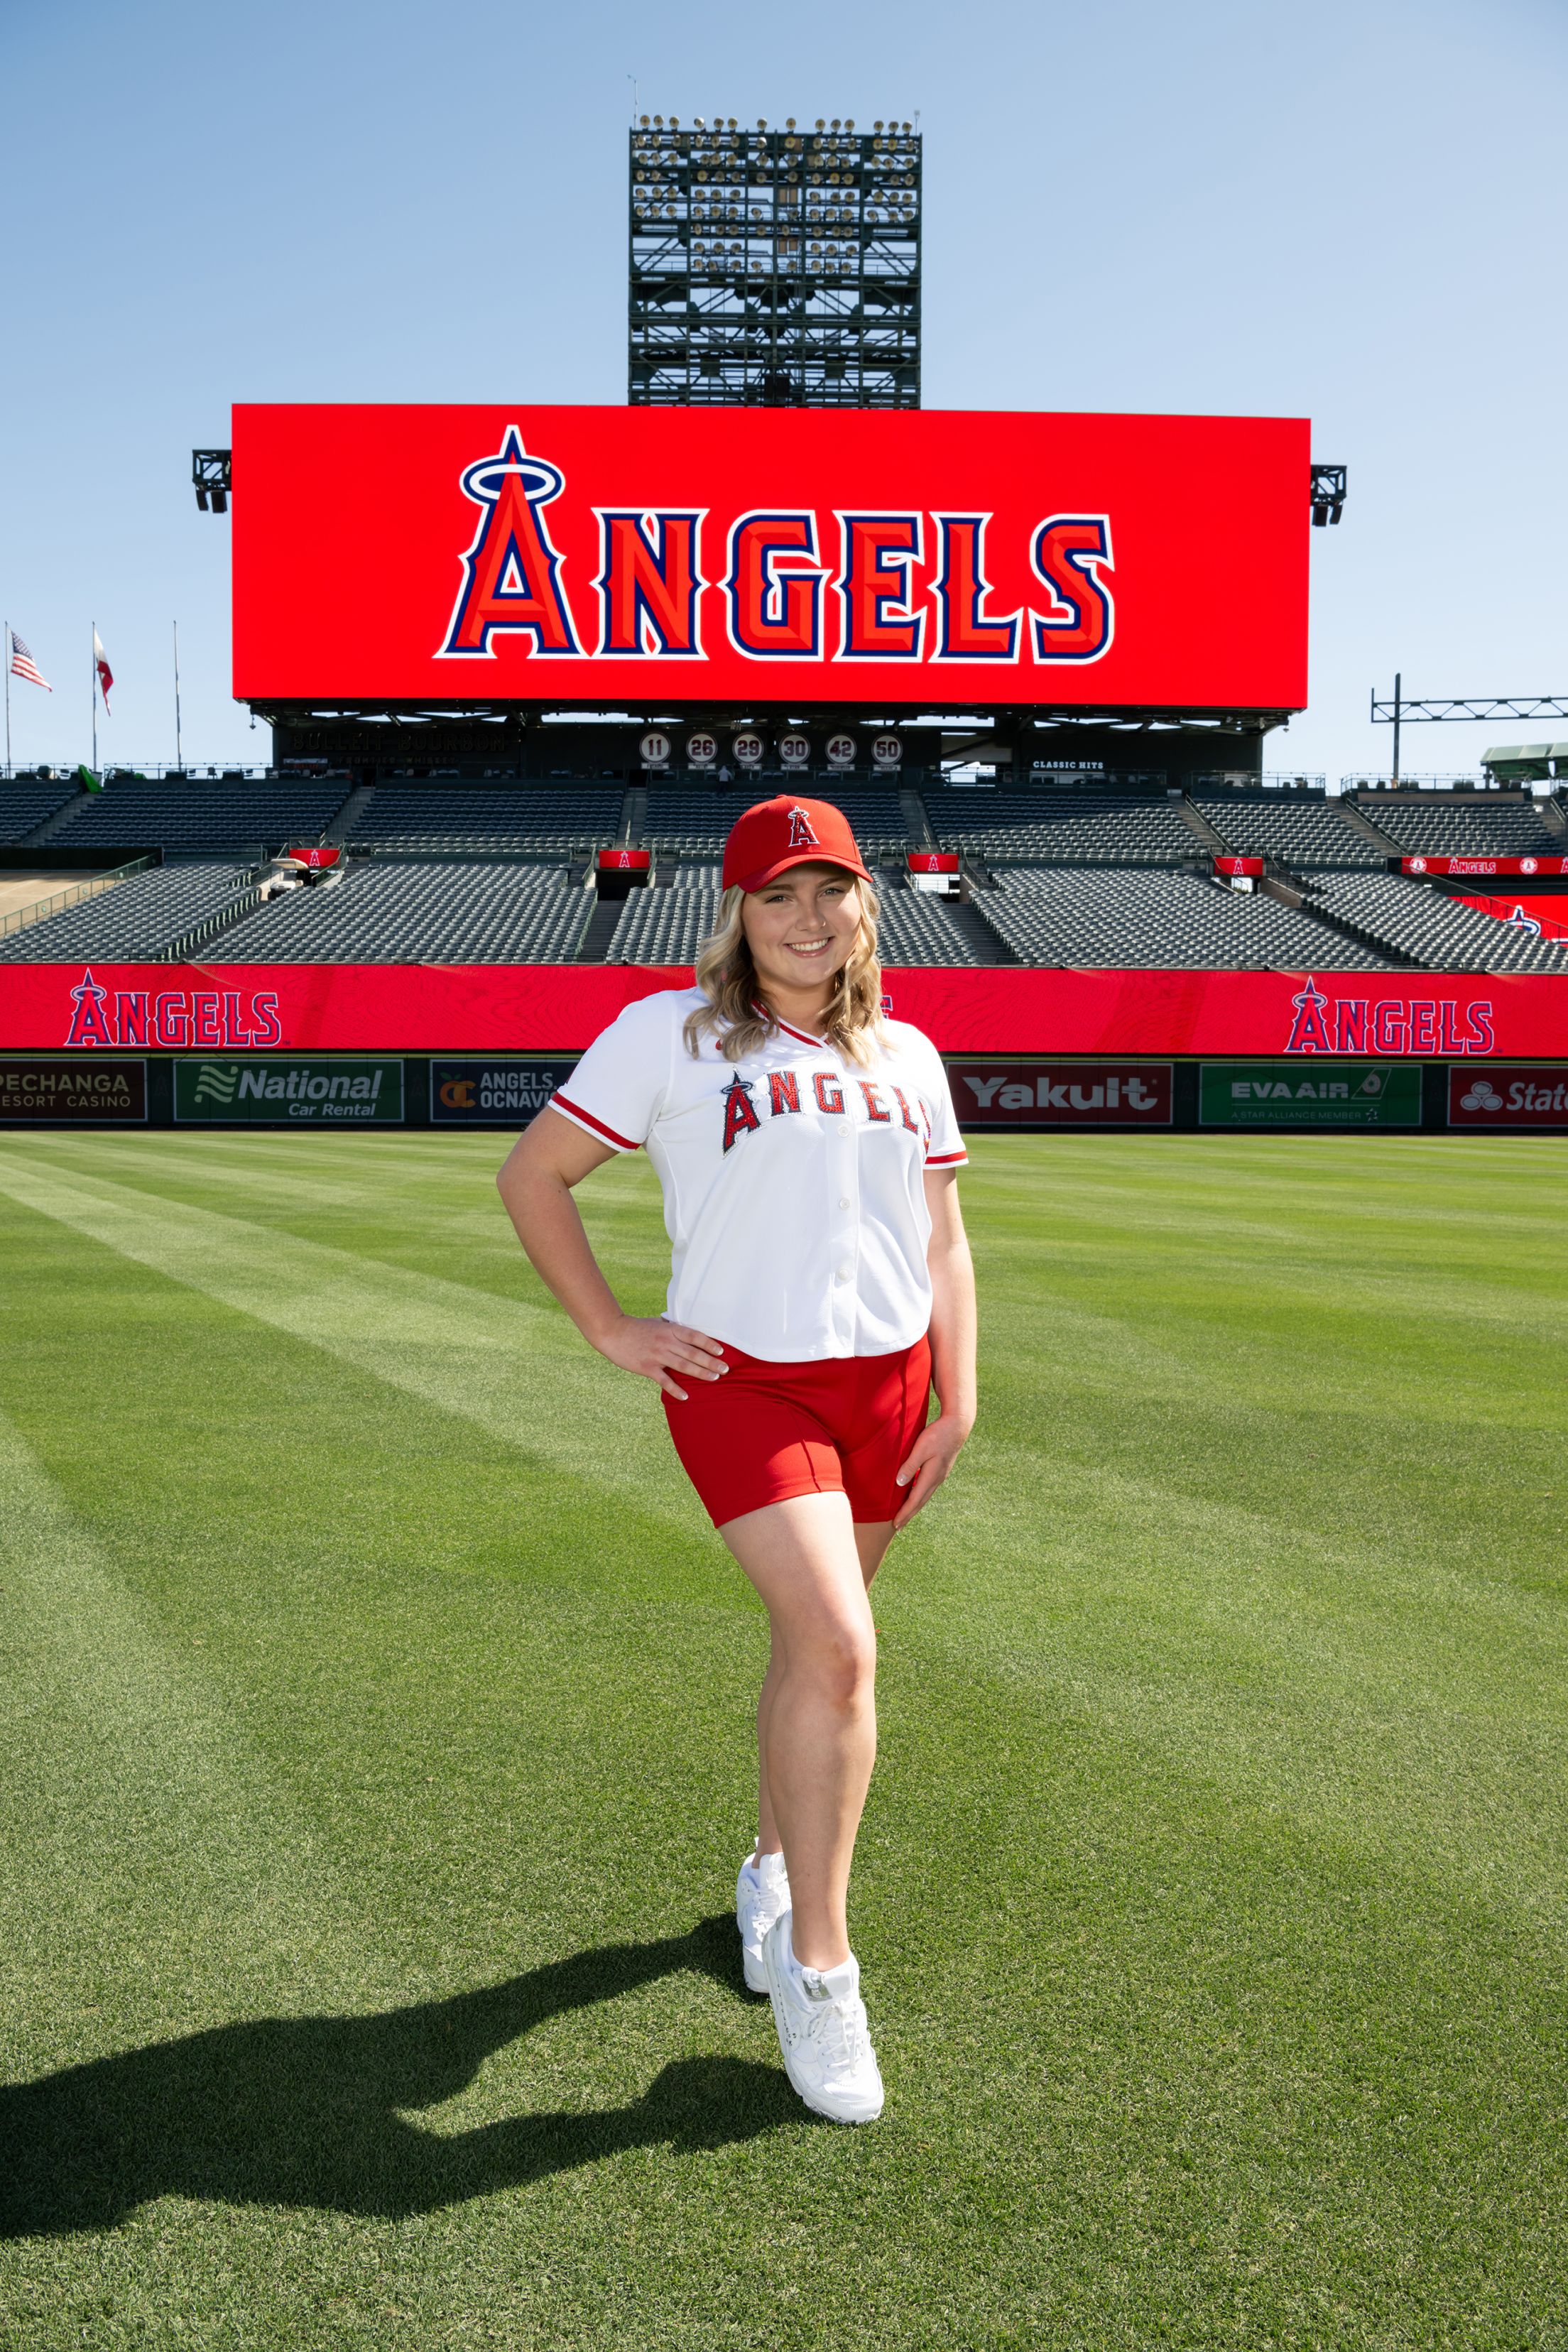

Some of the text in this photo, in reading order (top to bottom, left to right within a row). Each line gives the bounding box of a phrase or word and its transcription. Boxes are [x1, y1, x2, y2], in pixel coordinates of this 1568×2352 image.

[432, 424, 1115, 665] ANGELS
[648, 739, 662, 756] 11
[691, 739, 713, 756] 26
[738, 740, 759, 756] 29
[783, 741, 805, 757] 30
[829, 741, 852, 757] 42
[876, 741, 898, 758] 50
[1033, 761, 1076, 769] CLASSIC
[788, 805, 820, 847] A
[1448, 856, 1496, 874] ANGELS
[63, 967, 281, 1047] ANGELS
[1283, 975, 1494, 1054] ANGELS
[238, 1069, 383, 1099] National
[1, 1096, 131, 1107] ESORT CASINO
[480, 1091, 555, 1109] OCNAVI
[962, 1077, 1158, 1110] Yakult
[1506, 1082, 1568, 1111] Stat
[288, 1103, 376, 1116] Car Rental
[1240, 1111, 1265, 1119] STAR
[1268, 1111, 1315, 1119] ALLIANCE
[1318, 1111, 1362, 1120] MEMBER
